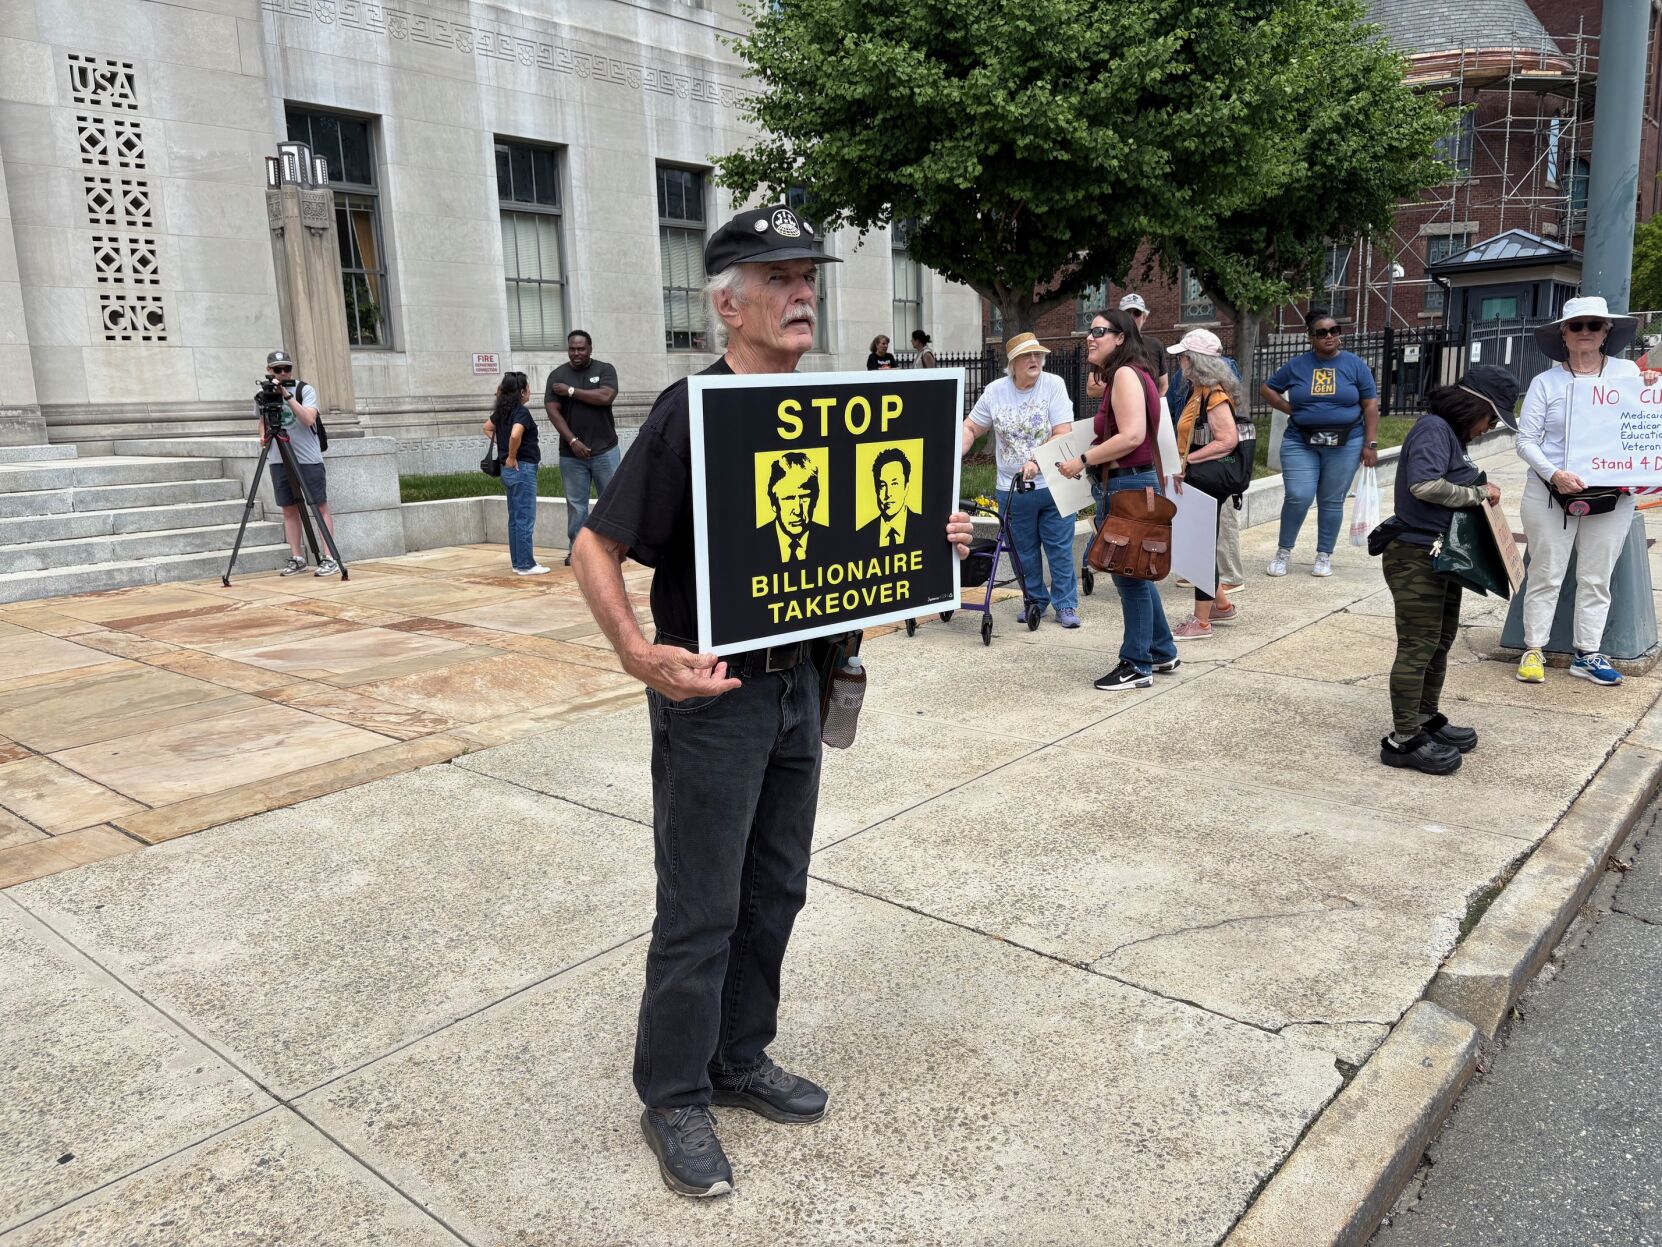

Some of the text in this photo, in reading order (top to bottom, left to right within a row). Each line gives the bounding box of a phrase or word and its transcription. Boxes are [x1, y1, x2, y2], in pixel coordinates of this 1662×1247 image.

[70, 65, 138, 101] USA
[1314, 385, 1333, 393] GEN
[1592, 385, 1620, 405] NO
[777, 394, 904, 440] STOP
[1591, 456, 1633, 470] Stand
[1640, 456, 1651, 470] 4
[751, 550, 924, 598] BILLIONAIRE
[767, 580, 911, 624] TAKEOVER
